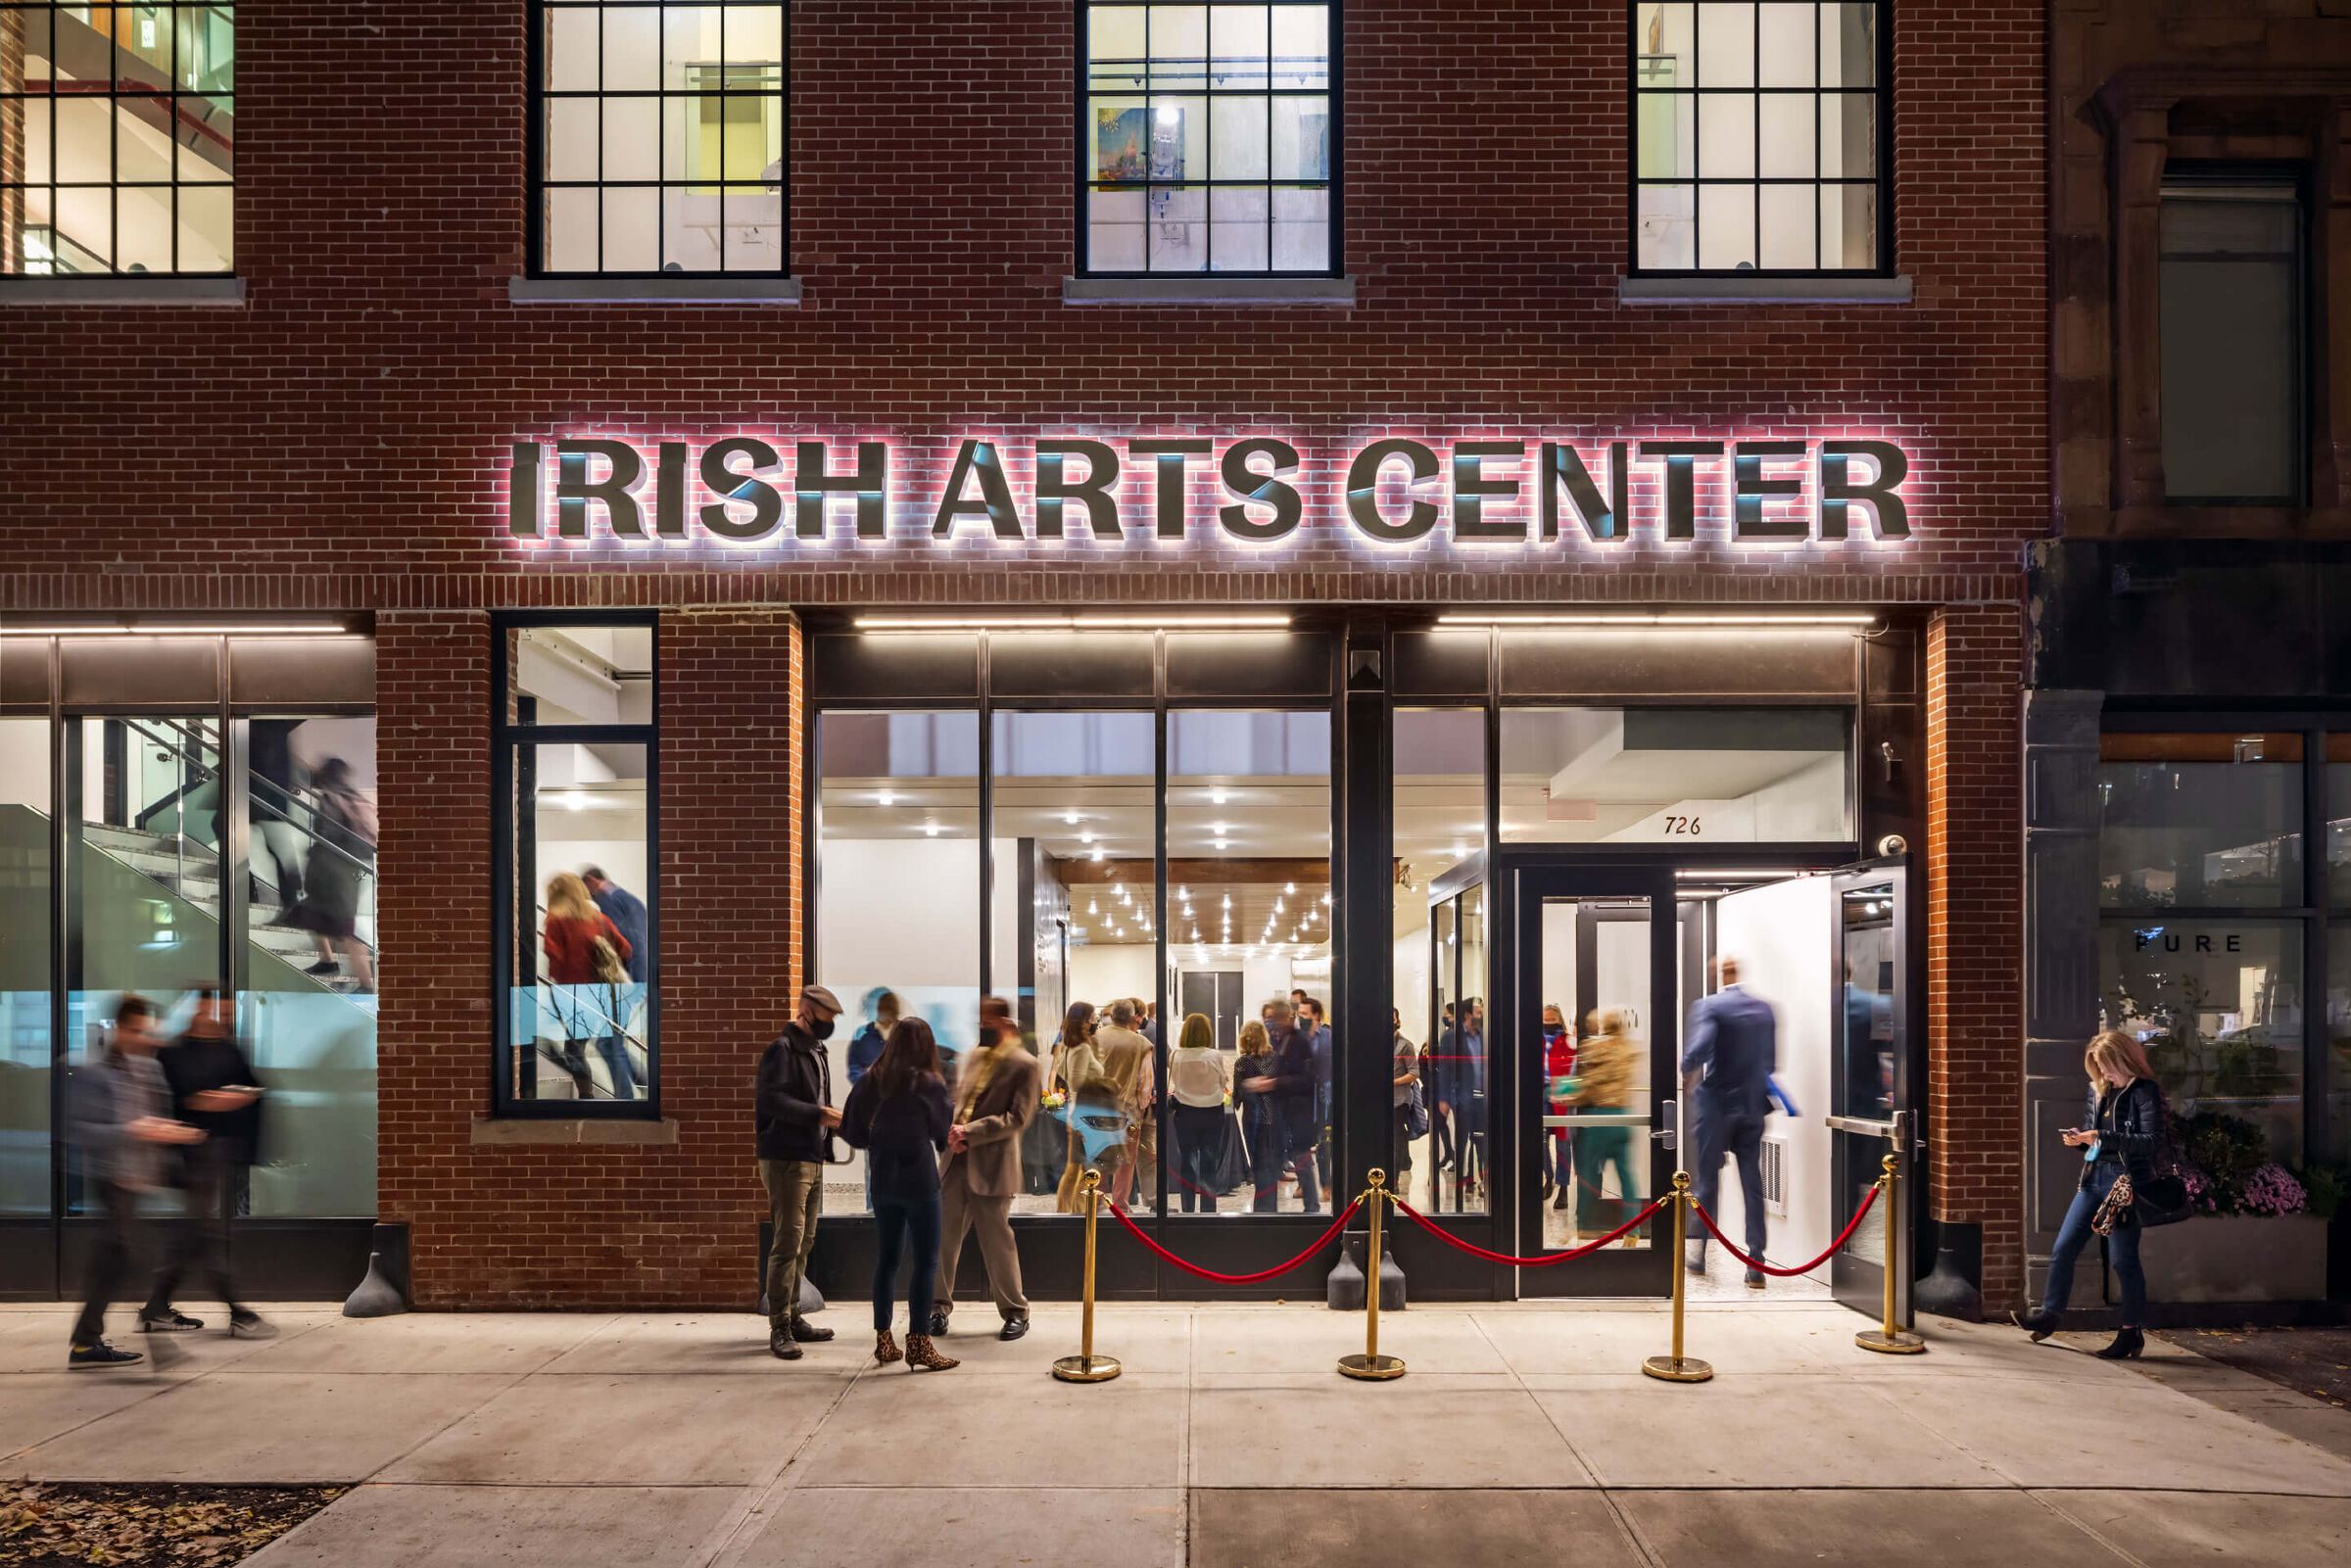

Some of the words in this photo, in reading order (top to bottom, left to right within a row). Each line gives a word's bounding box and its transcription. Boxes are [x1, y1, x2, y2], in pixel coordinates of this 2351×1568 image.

[509, 437, 887, 541] IRISH
[931, 437, 1303, 542] ARTS
[1346, 438, 1912, 543] CENTER
[1664, 816, 1701, 835] 726
[2135, 934, 2240, 953] PURE
